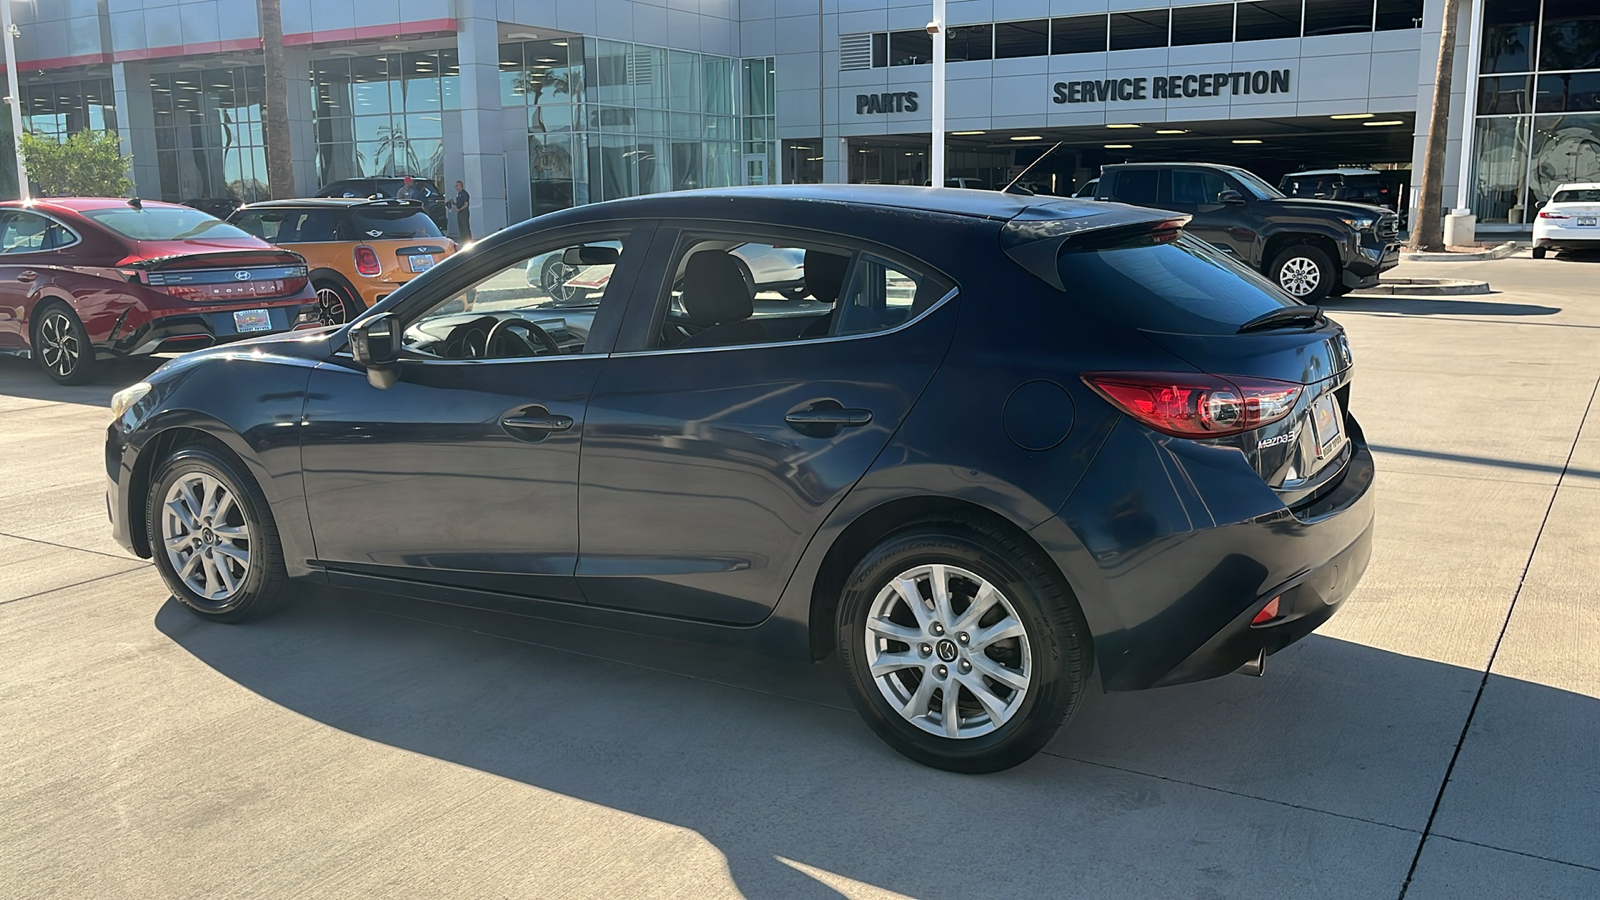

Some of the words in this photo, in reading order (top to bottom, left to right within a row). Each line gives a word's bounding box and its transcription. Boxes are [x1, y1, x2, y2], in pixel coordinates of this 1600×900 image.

[1053, 77, 1147, 104] SERVICE
[1152, 69, 1290, 99] RECEPTION
[856, 91, 919, 114] PARTS
[213, 285, 276, 294] SONATA
